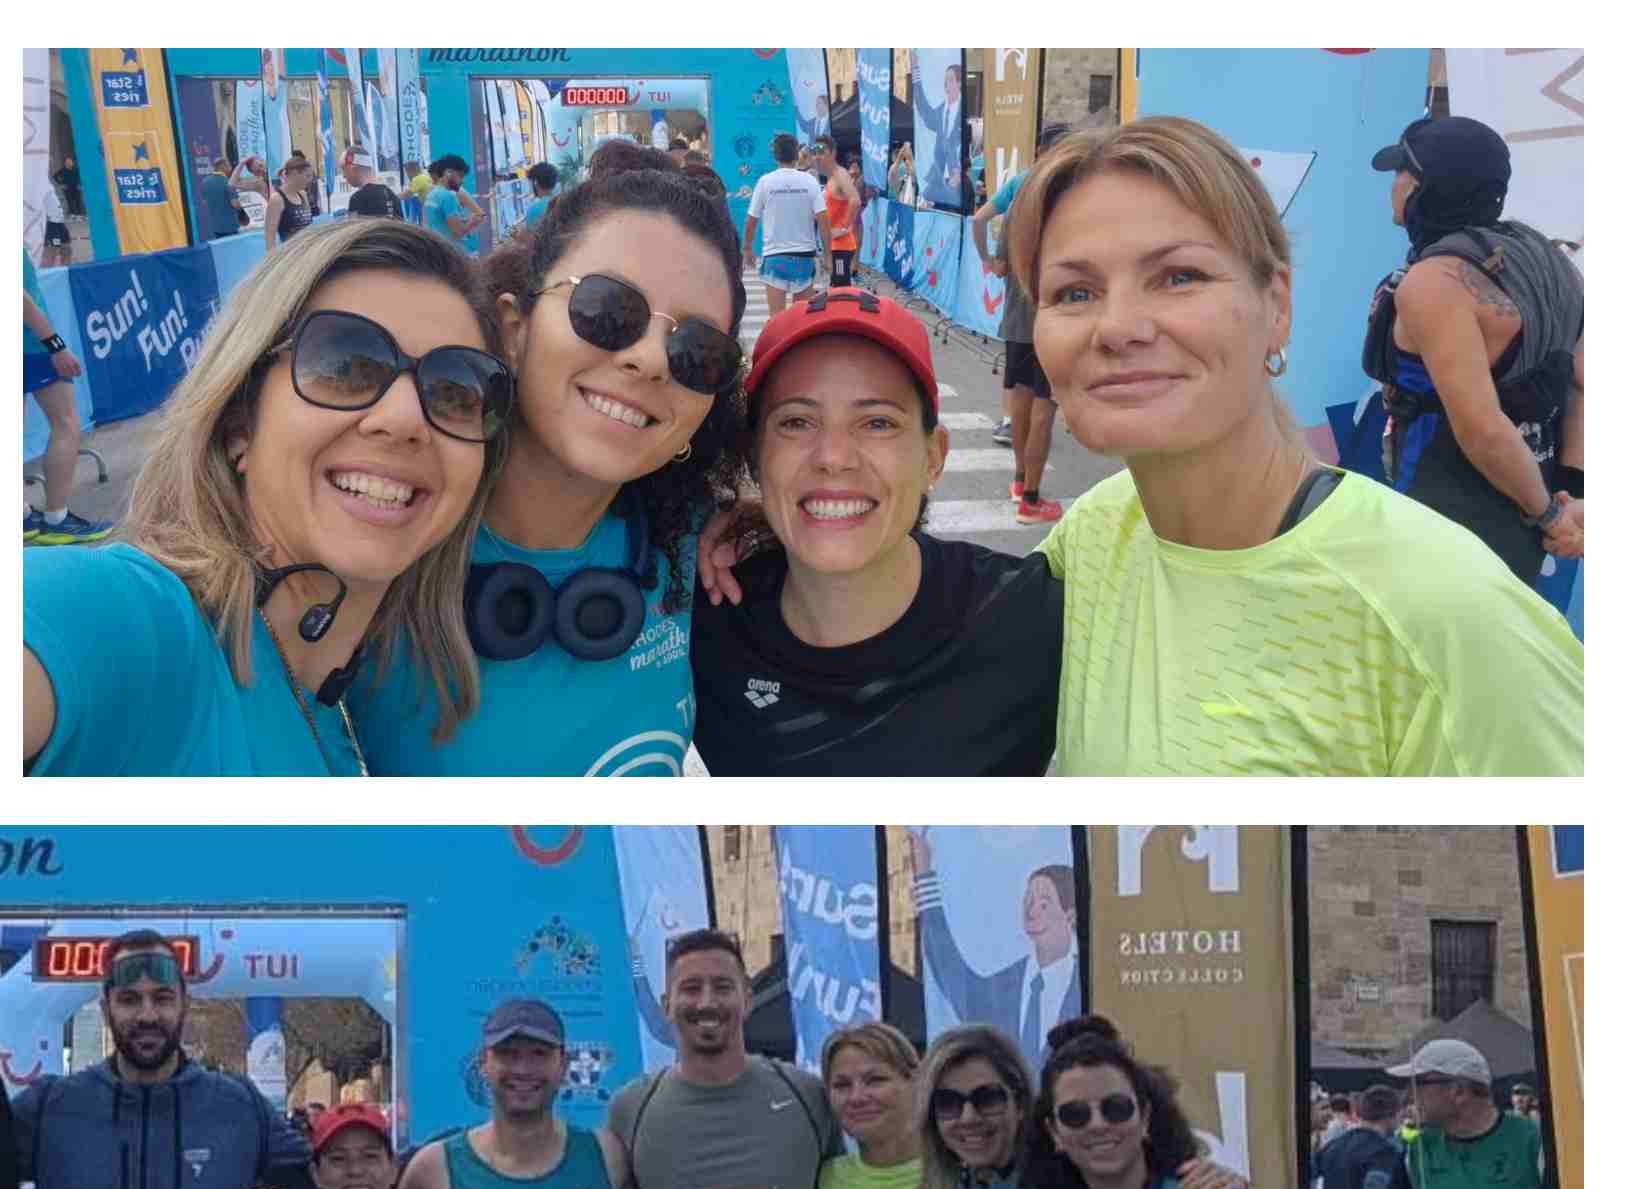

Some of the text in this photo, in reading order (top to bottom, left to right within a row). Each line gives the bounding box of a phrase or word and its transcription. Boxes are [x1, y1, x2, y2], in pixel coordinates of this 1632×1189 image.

[86, 268, 148, 359] Sun!
[137, 289, 188, 373] Fun!
[632, 616, 676, 649] HODES
[747, 677, 781, 693] arena
[242, 954, 300, 980] TUI
